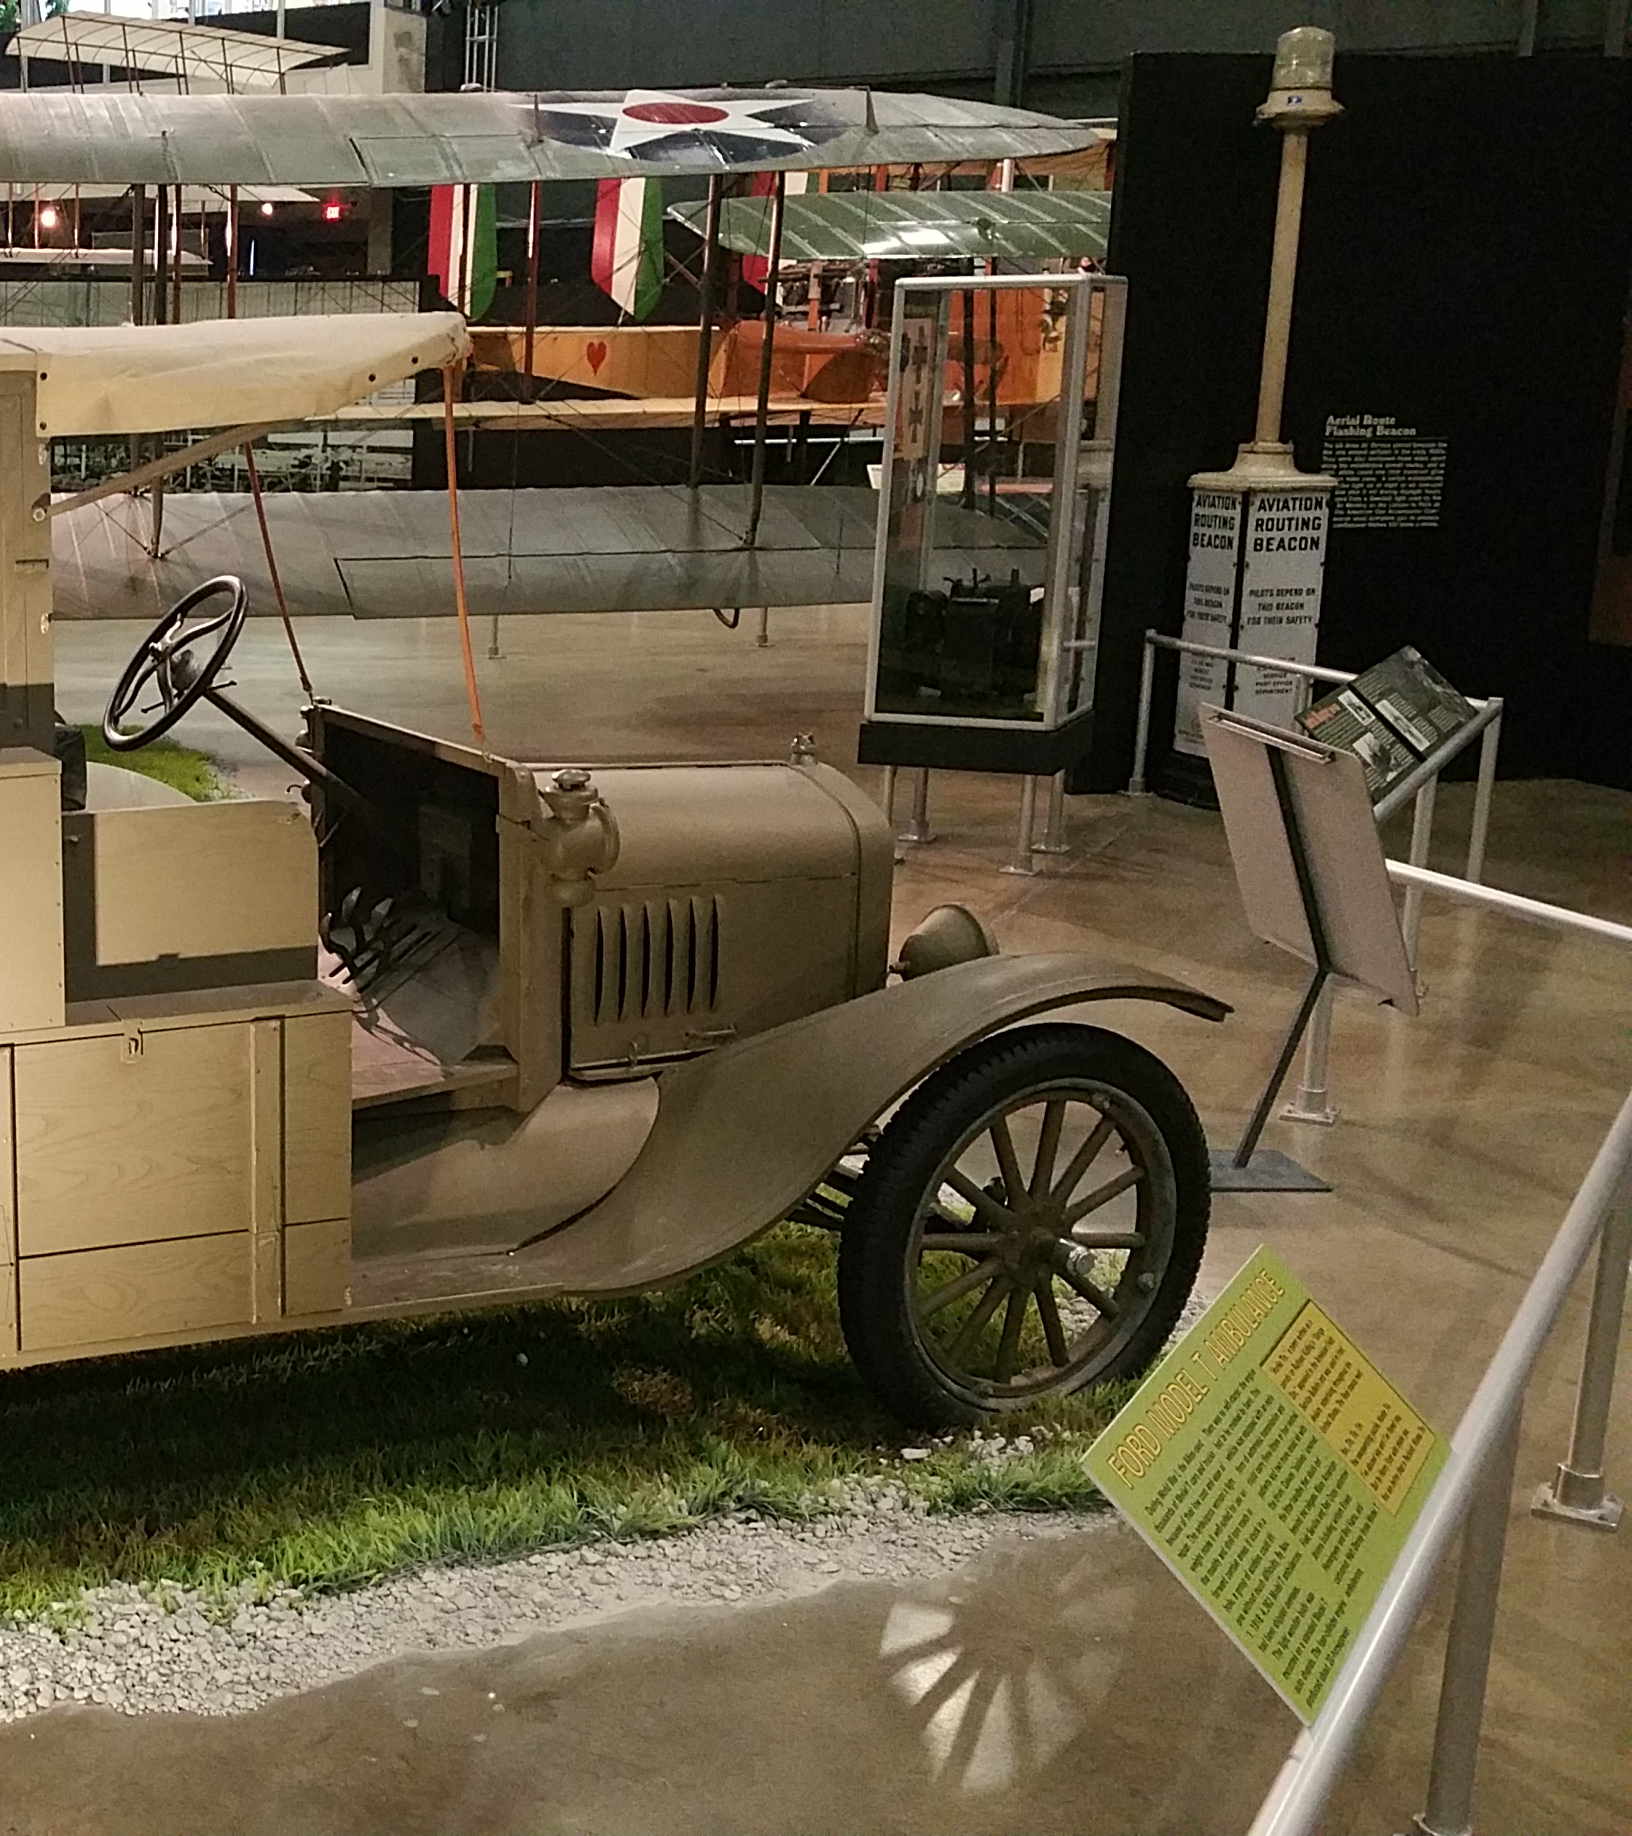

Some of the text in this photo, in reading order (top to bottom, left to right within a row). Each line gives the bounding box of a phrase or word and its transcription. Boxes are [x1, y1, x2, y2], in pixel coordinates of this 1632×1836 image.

[1327, 414, 1397, 426] Aerial Route
[1325, 425, 1417, 438] Flashing Beacon
[1195, 494, 1237, 511] AVIATION
[1257, 496, 1324, 512] AVIATION
[1194, 513, 1235, 531] ROUTING
[1254, 516, 1322, 532] ROUTING
[1192, 533, 1234, 550] BEACON
[1253, 536, 1320, 552] BEACON
[1249, 587, 1316, 598] PILOTS DEPEND ON
[1203, 1268, 1285, 1369] AMBULANCE
[1190, 1349, 1220, 1382] T
[1146, 1368, 1210, 1439] MODEL
[1107, 1423, 1163, 1490] FORD
